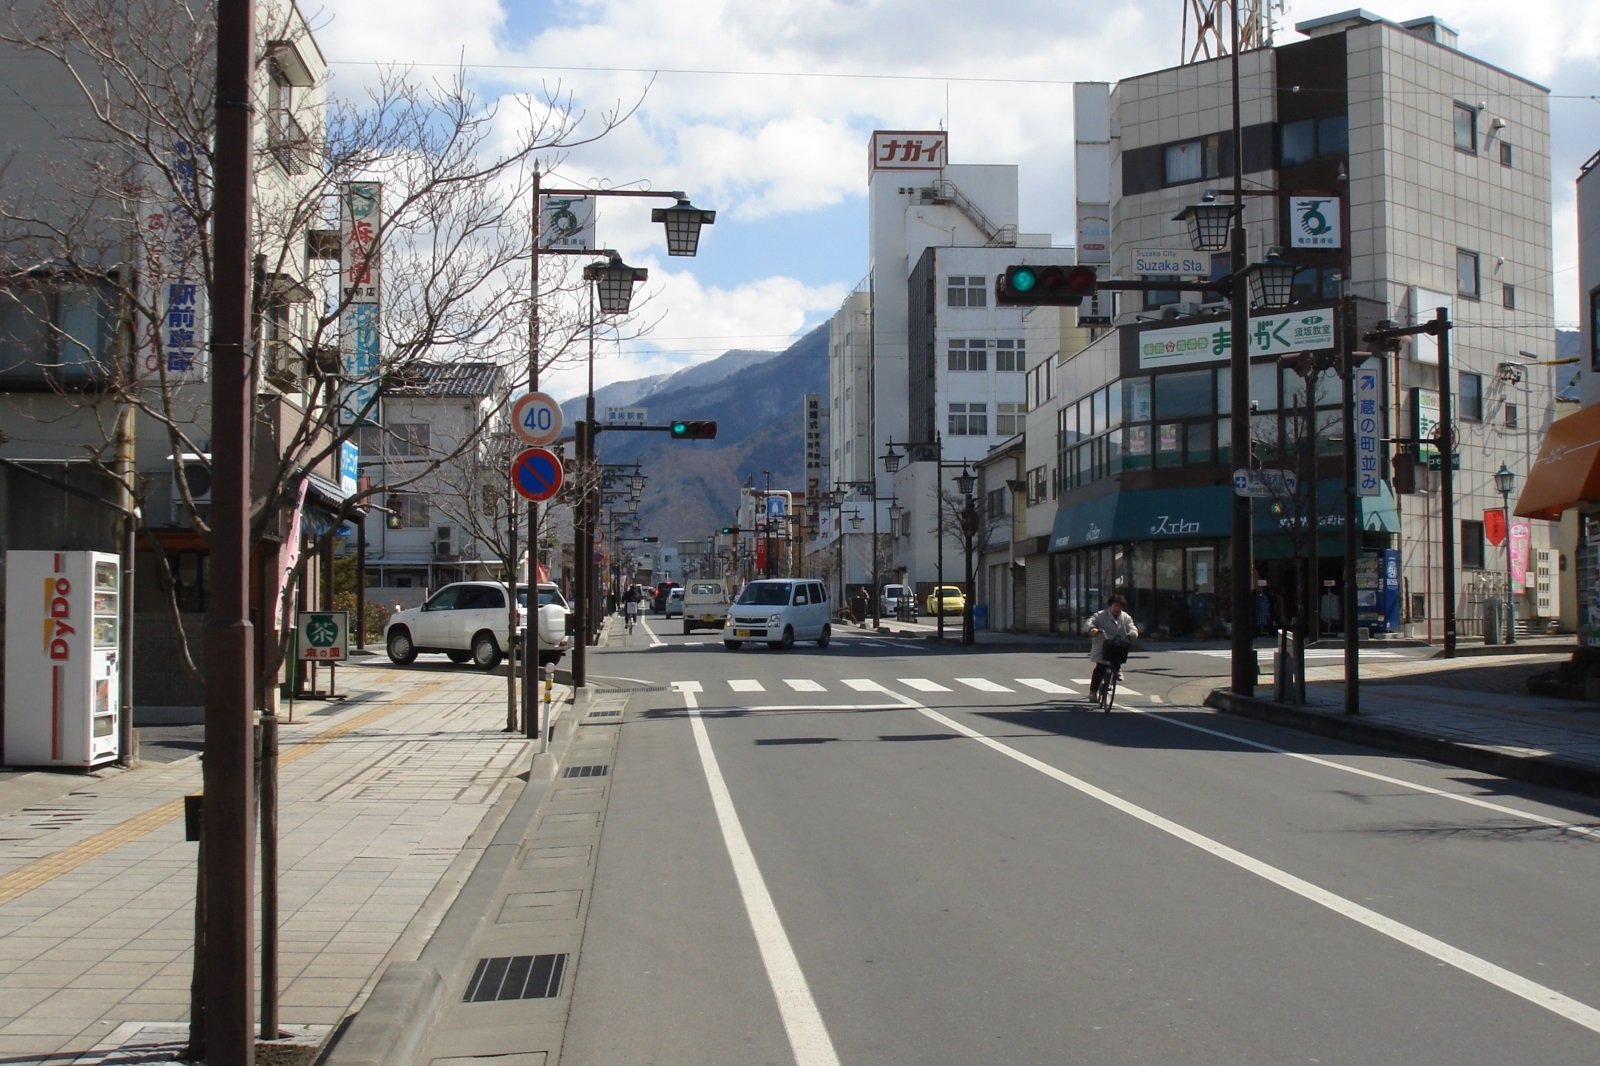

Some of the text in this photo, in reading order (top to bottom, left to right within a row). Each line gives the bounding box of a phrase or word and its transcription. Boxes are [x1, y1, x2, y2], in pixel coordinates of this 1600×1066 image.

[880, 140, 942, 162] ナガイ
[1136, 259, 1205, 272] Suzaka Sta.
[1162, 250, 1176, 258] City
[167, 283, 196, 372] 駅前車庫
[1212, 318, 1291, 355] まがく
[524, 407, 551, 431] 40
[1359, 399, 1377, 489] 蔵の町並み
[50, 577, 76, 660] DyDo
[312, 621, 334, 643] 茶
[304, 648, 340, 658] 麻の園
